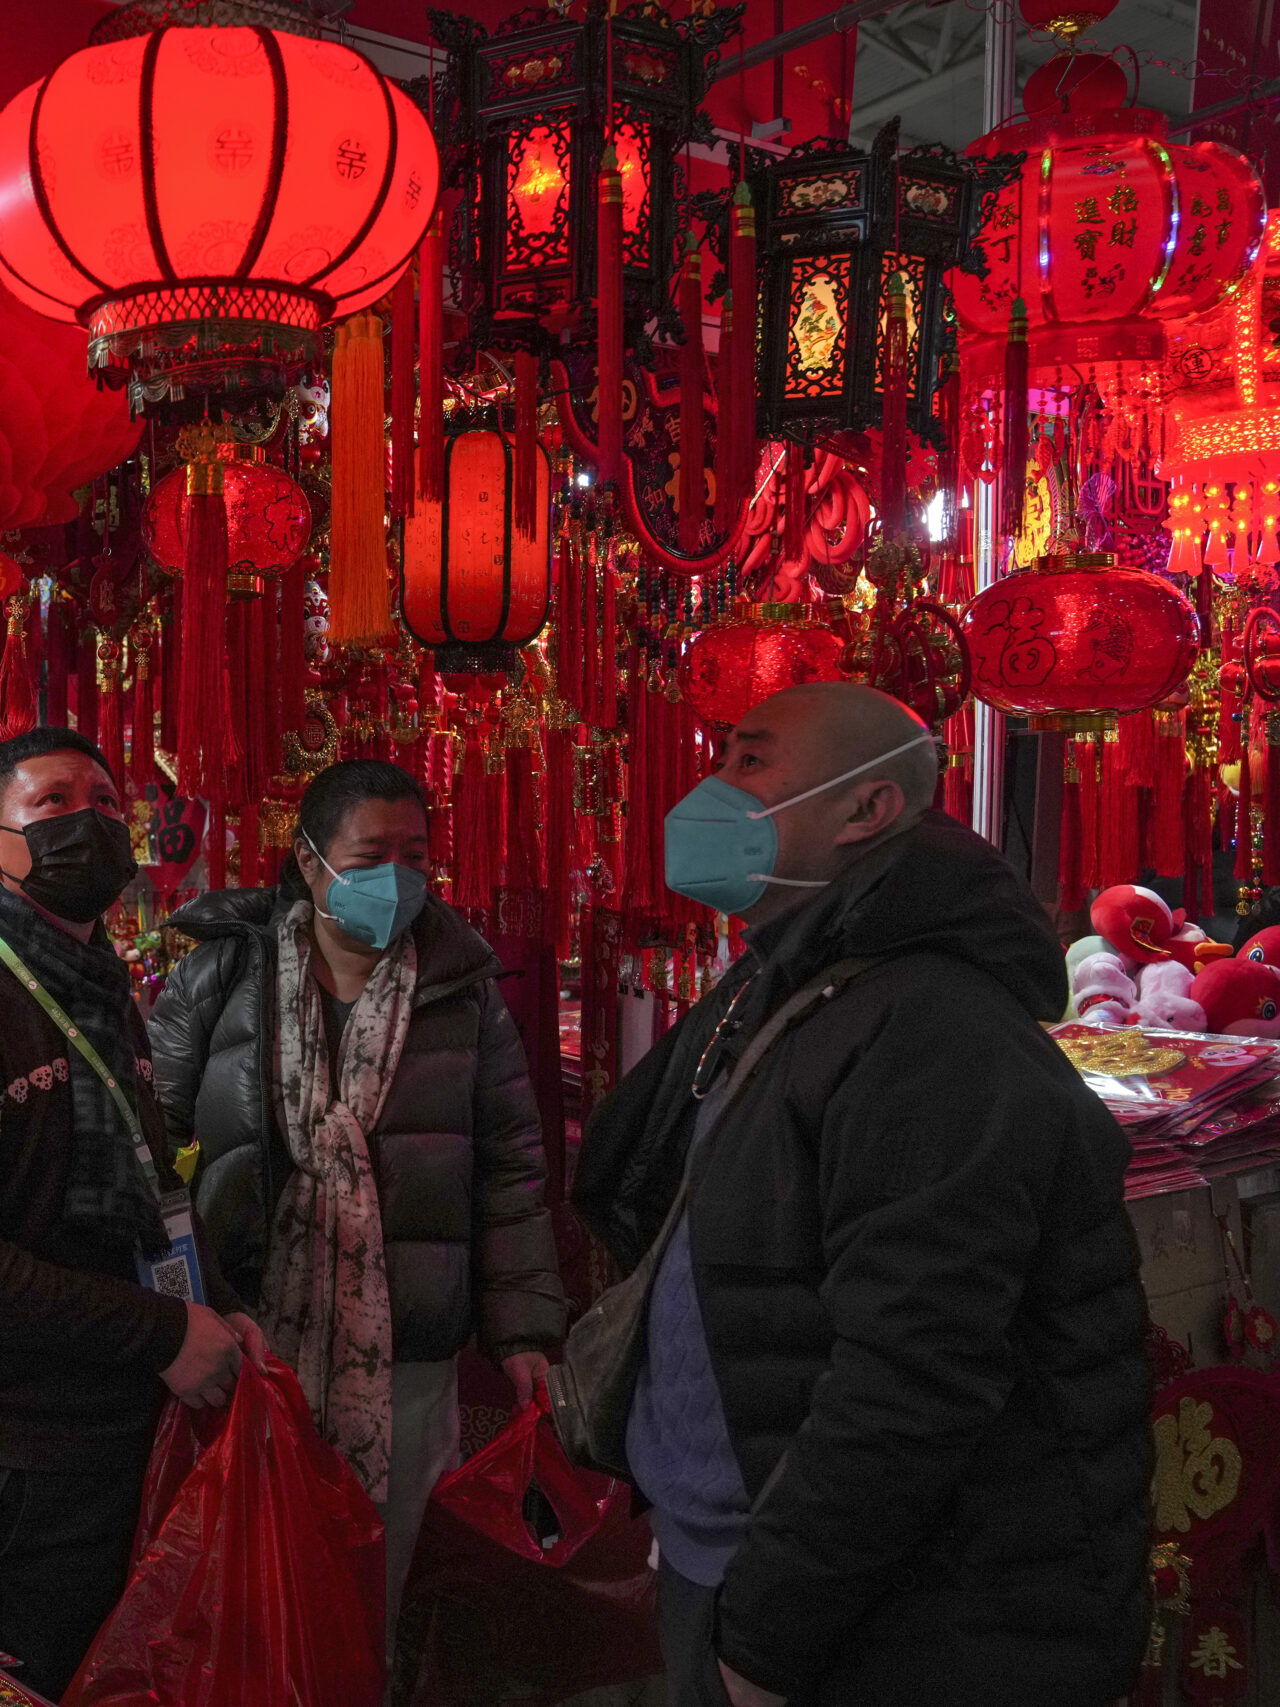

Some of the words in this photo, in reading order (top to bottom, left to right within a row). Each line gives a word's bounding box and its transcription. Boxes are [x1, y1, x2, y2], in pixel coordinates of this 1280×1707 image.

[1074, 197, 1105, 261] 進寶
[1106, 185, 1138, 248] 招財
[1151, 1396, 1243, 1534] 福
[1190, 1627, 1244, 1679] 春
